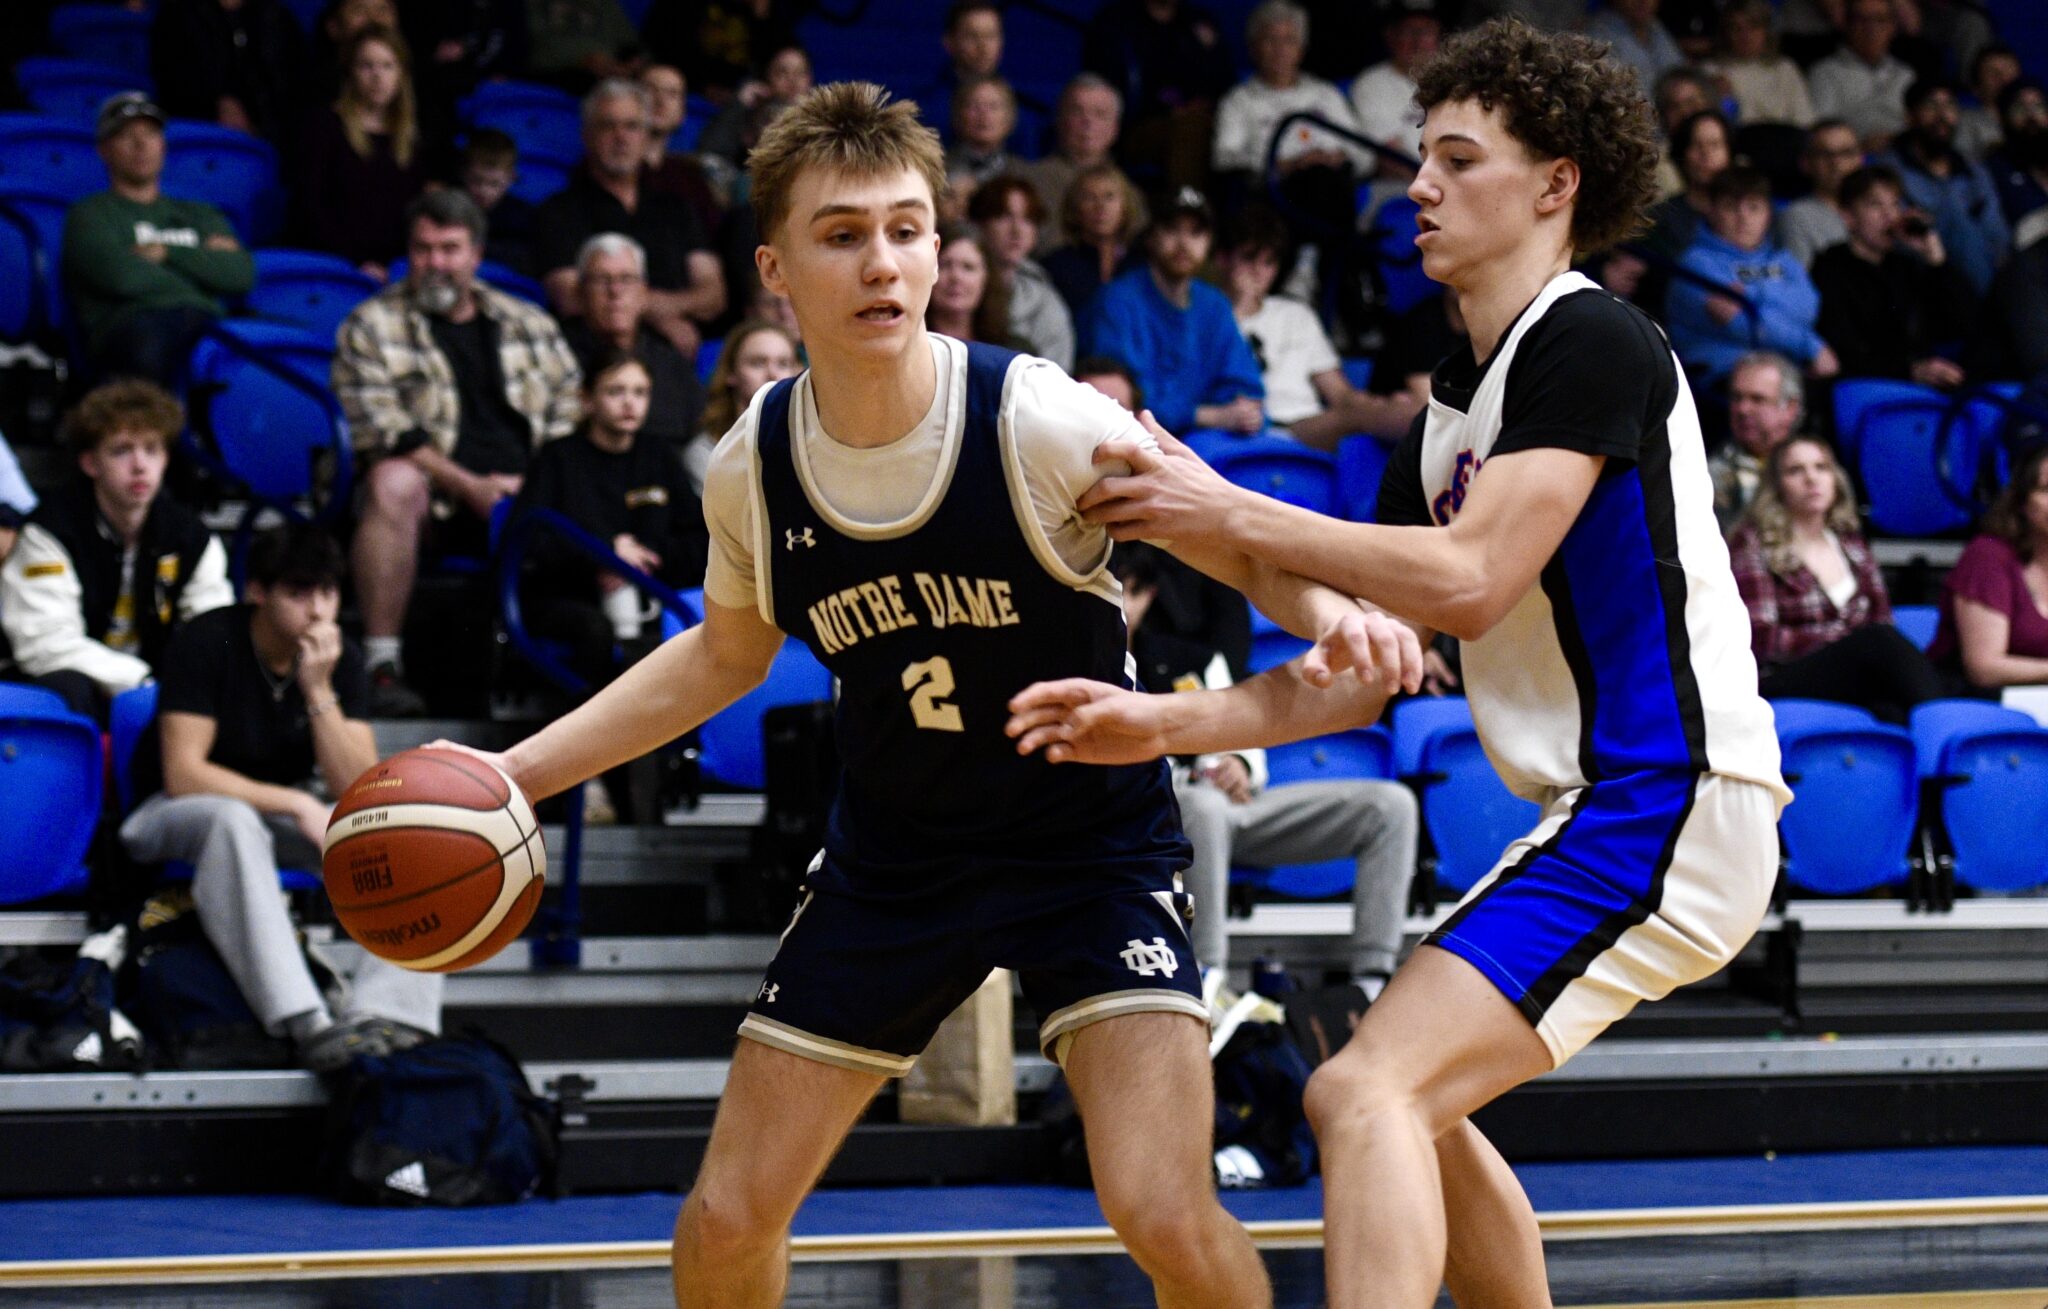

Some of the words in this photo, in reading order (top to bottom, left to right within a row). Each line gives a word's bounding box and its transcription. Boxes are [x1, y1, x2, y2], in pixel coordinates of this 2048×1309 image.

[807, 574, 919, 655] NOTRE
[912, 571, 1021, 629] DAME
[901, 655, 965, 732] 2
[352, 812, 388, 828] BG4500
[352, 865, 393, 894] FIBA
[361, 912, 441, 945] molten
